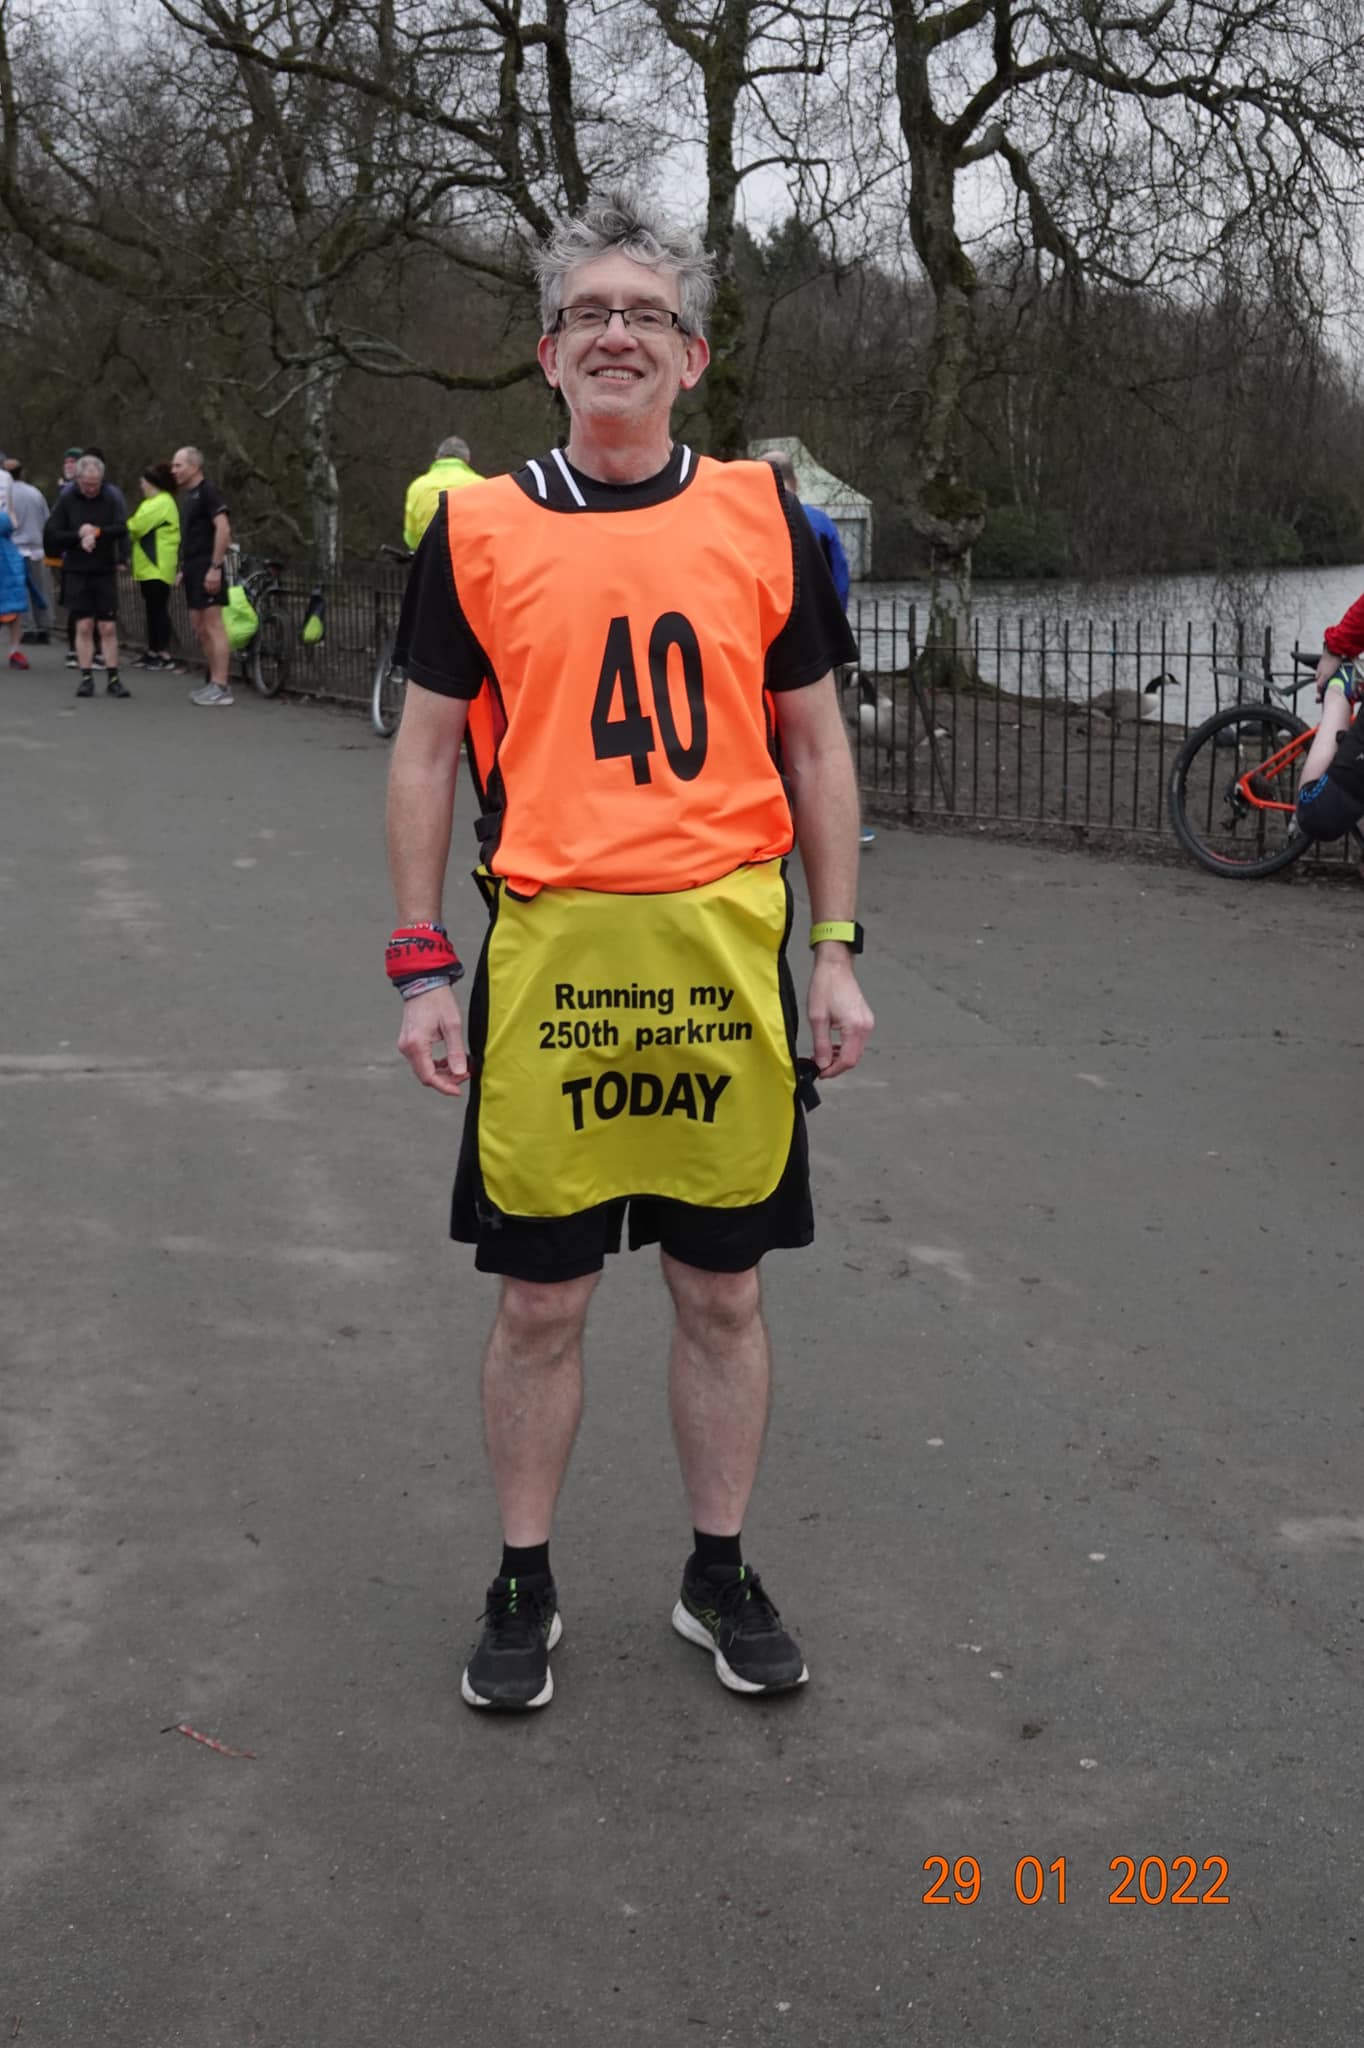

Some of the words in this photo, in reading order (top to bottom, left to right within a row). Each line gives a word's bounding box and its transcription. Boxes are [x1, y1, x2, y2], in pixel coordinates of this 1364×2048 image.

[590, 611, 708, 786] 40
[555, 983, 674, 1015] Running
[690, 986, 735, 1011] my
[539, 1020, 619, 1049] 250th
[635, 1018, 754, 1052] parkrun
[562, 1070, 732, 1131] TODAY
